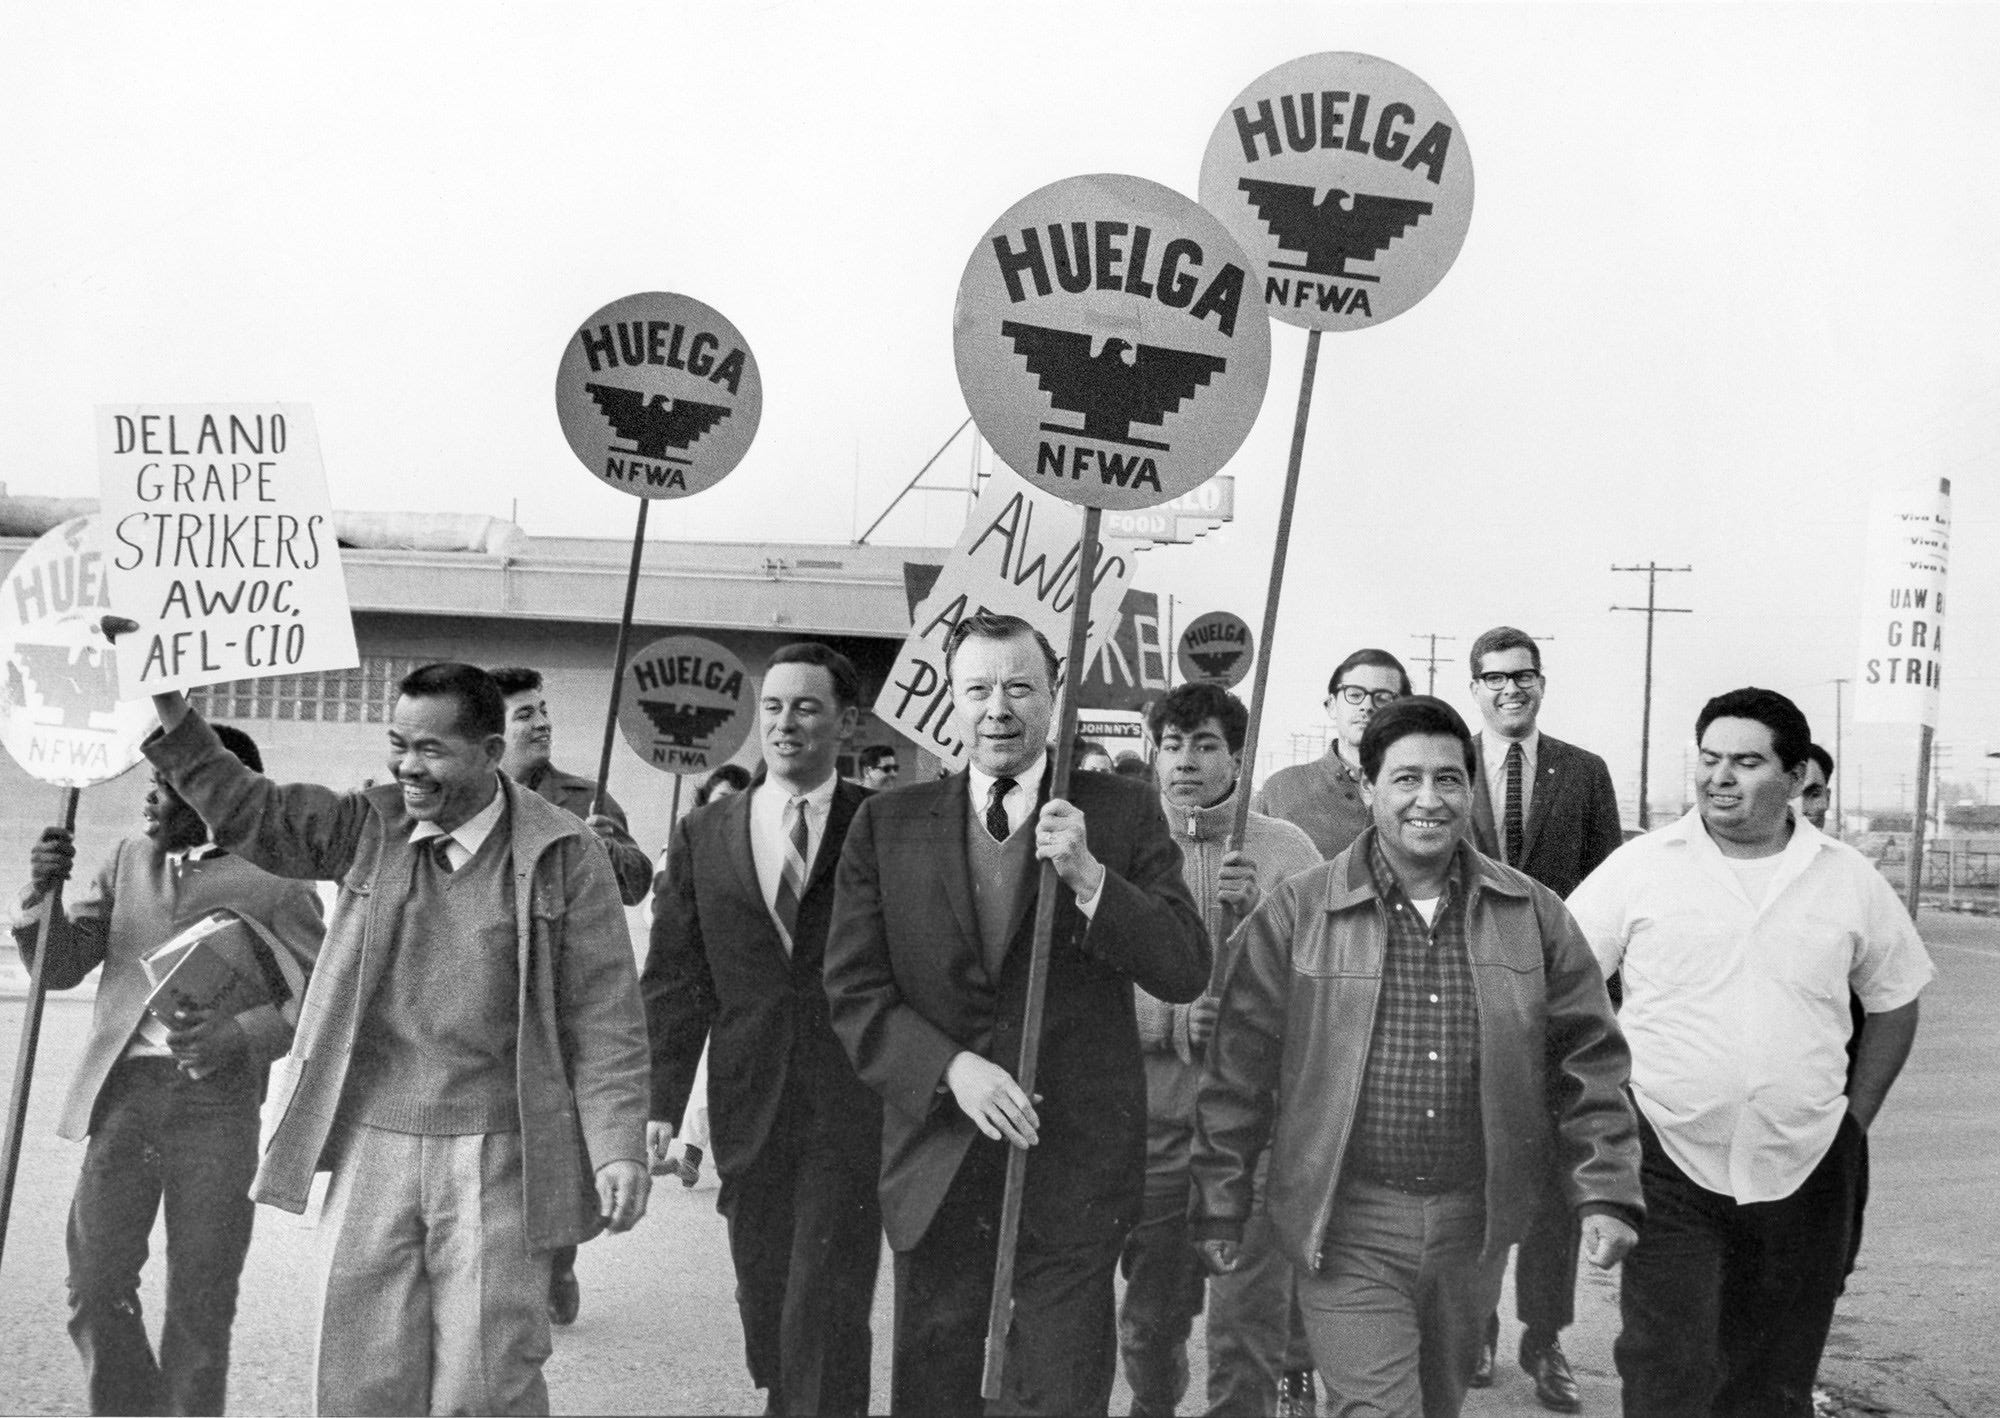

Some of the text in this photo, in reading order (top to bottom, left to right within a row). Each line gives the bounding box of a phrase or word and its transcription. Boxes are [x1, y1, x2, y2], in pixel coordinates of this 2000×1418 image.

[1232, 90, 1452, 184] HUELGA
[992, 220, 1245, 338] HUELGA
[1264, 276, 1372, 317] NFWA
[580, 320, 746, 396] HUELGA
[114, 413, 287, 454] DELANO
[137, 462, 277, 502] GRAPE
[605, 457, 686, 491] NFWA
[1036, 441, 1162, 492] NFWA
[115, 512, 324, 571] STRIKERS
[1109, 514, 1166, 534] FOOD
[160, 580, 301, 619] AWOC,
[1890, 589, 1928, 609] UAW
[140, 623, 304, 681] AFL-CIO
[1184, 623, 1246, 649] HUELGA
[633, 656, 744, 701] HUELGA
[1080, 722, 1141, 734] JOHNNY'S
[29, 736, 108, 768] NFWA
[652, 748, 708, 767] NFWA
